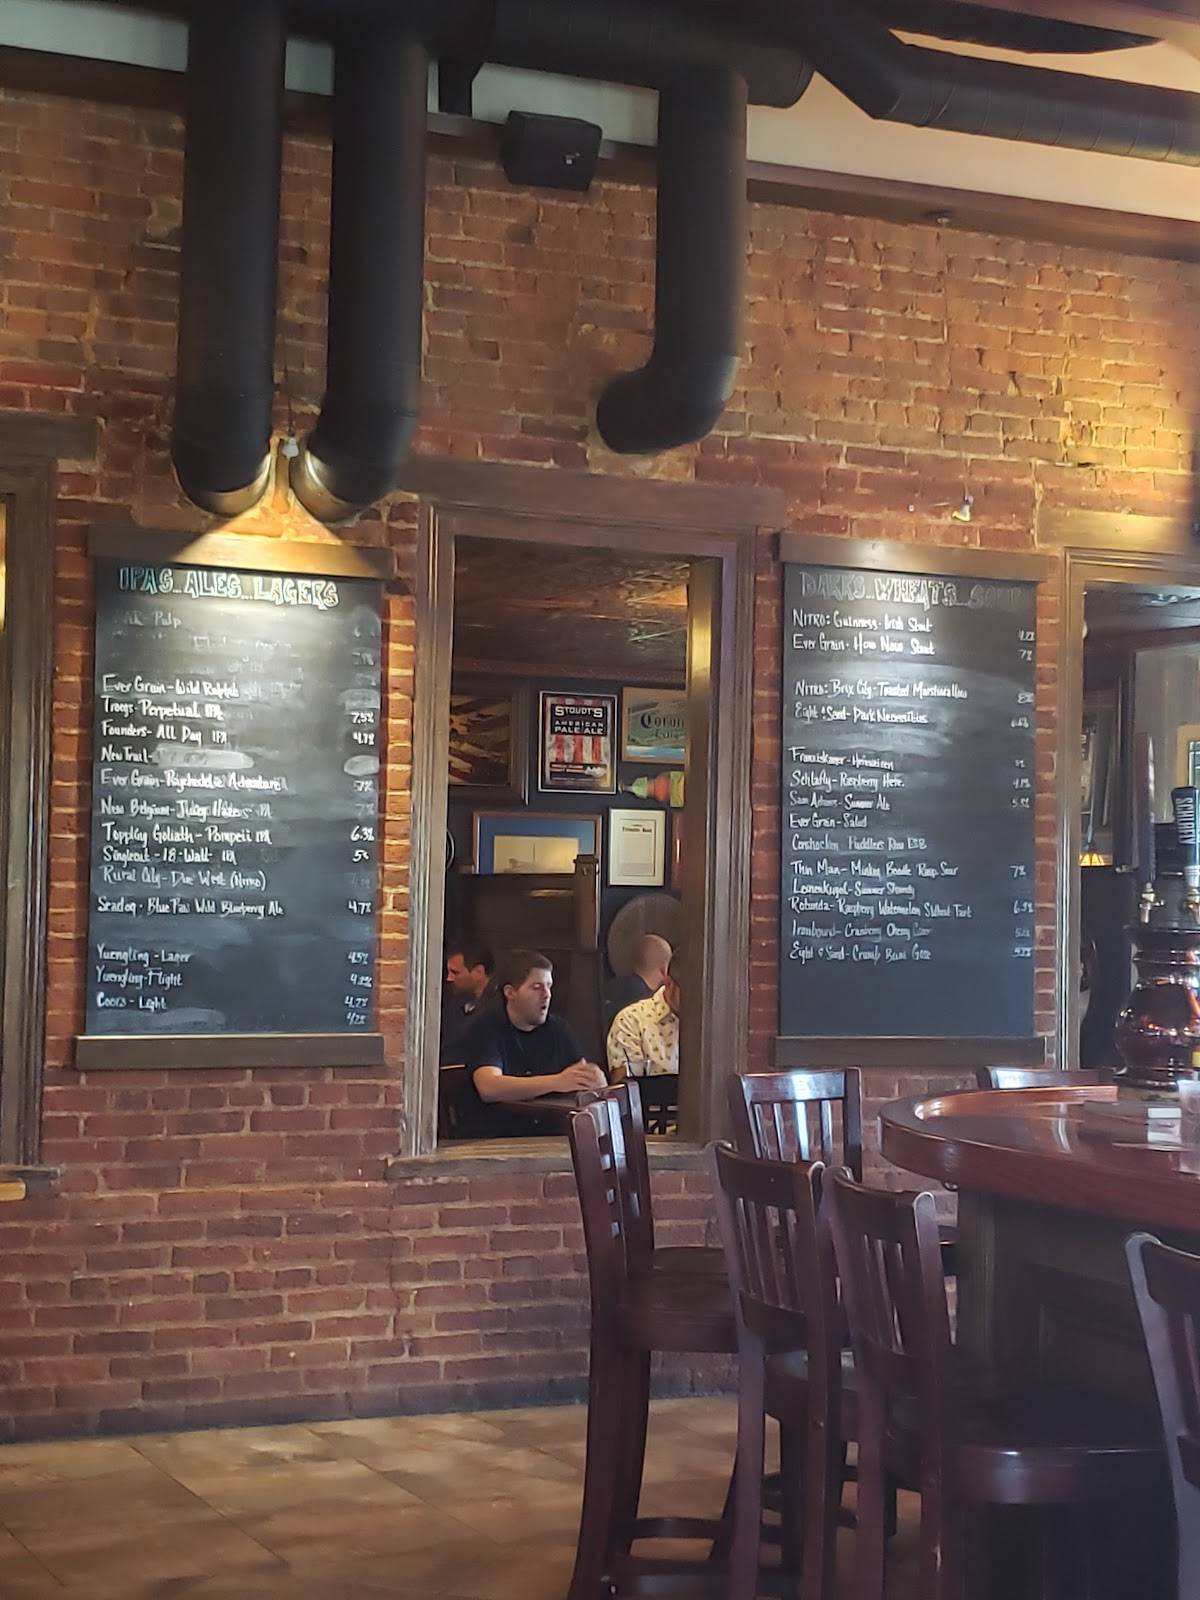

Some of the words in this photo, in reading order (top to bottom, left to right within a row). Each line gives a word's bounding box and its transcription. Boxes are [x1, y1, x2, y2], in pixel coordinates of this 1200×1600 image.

[793, 633, 818, 649] Ever
[102, 674, 132, 693] Ever
[156, 724, 177, 740] All
[554, 720, 604, 728] AMERICAN
[554, 725, 580, 735] PALE
[583, 727, 604, 736] ALE
[101, 744, 124, 762] New
[100, 768, 127, 786] Ever
[100, 794, 125, 815] New
[789, 790, 809, 807] Sam
[875, 793, 891, 811] Ale
[789, 813, 812, 828] Ever
[268, 900, 285, 916] Ale
